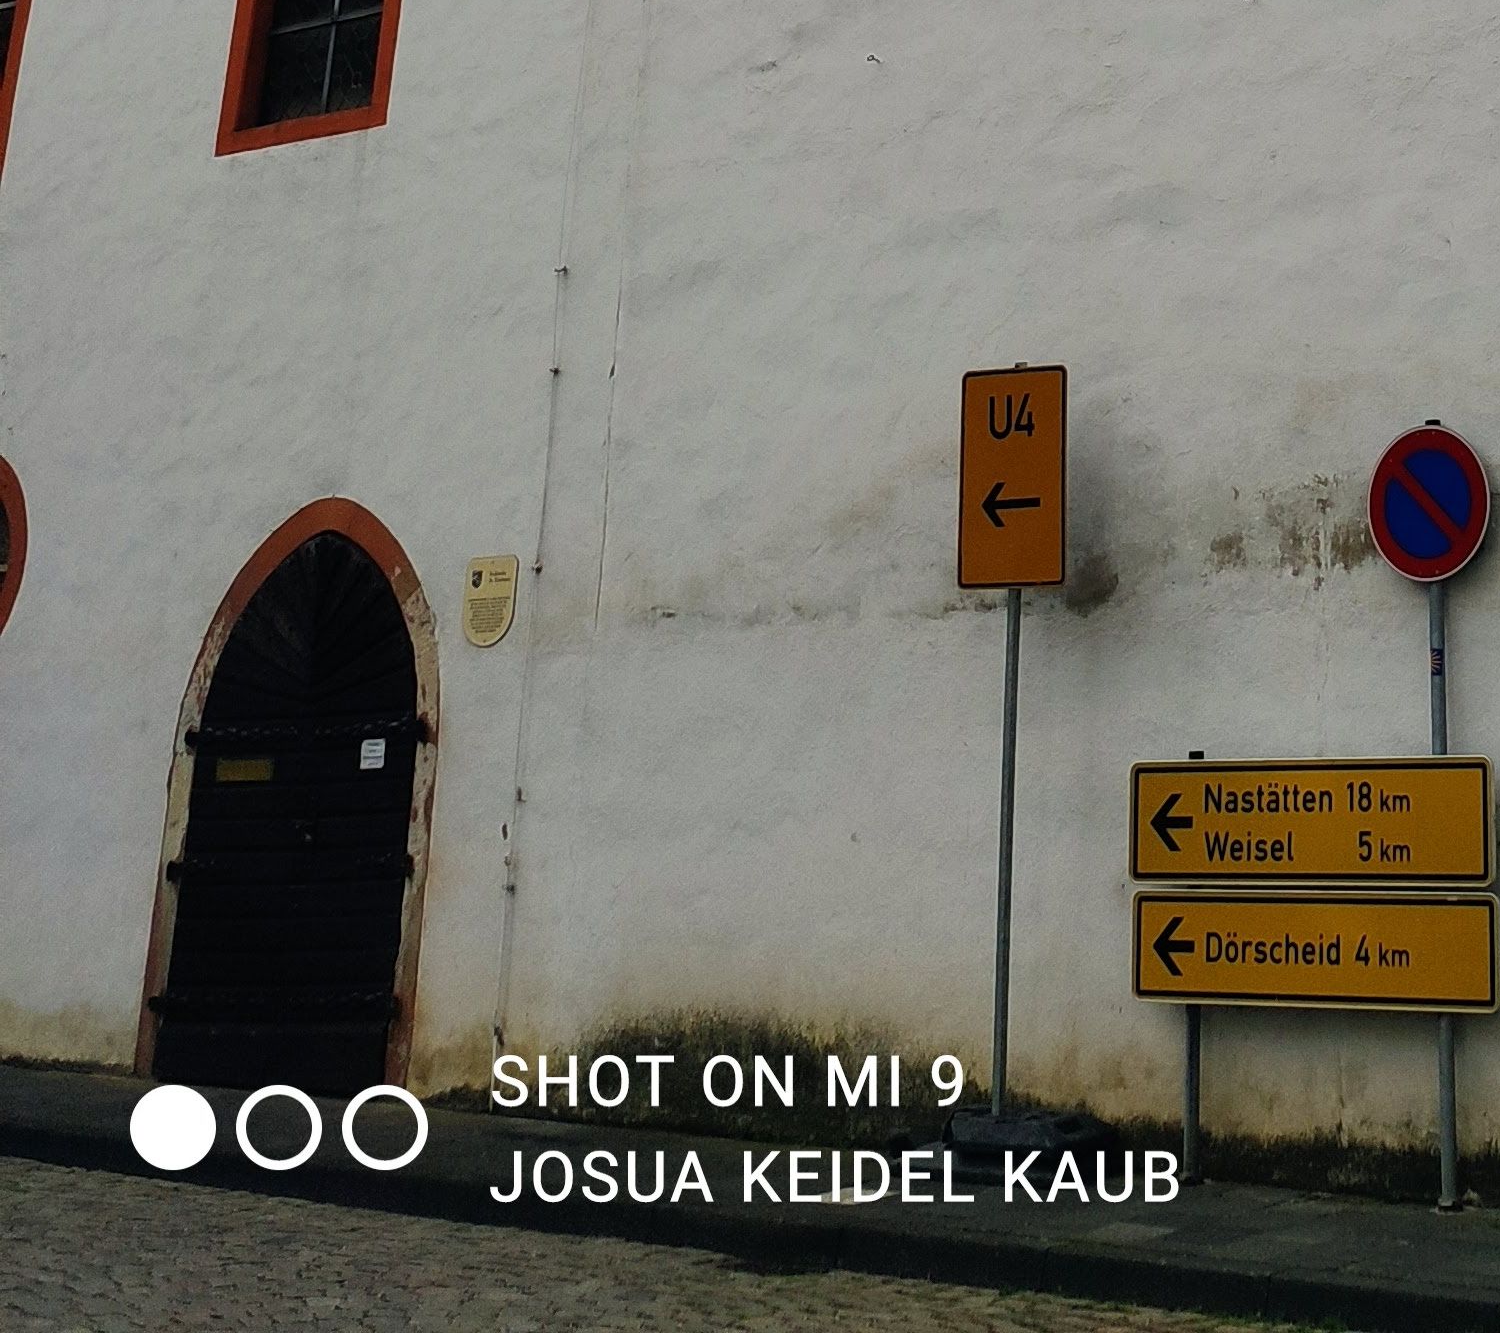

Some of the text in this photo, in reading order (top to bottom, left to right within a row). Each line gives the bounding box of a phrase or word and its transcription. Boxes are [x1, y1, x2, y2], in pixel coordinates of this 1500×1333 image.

[989, 393, 1036, 440] U4
[1204, 781, 1411, 813] Nastätten 18 km
[1204, 831, 1411, 862] Weisel 5 km
[1205, 931, 1410, 967] Dörscheid 4 km
